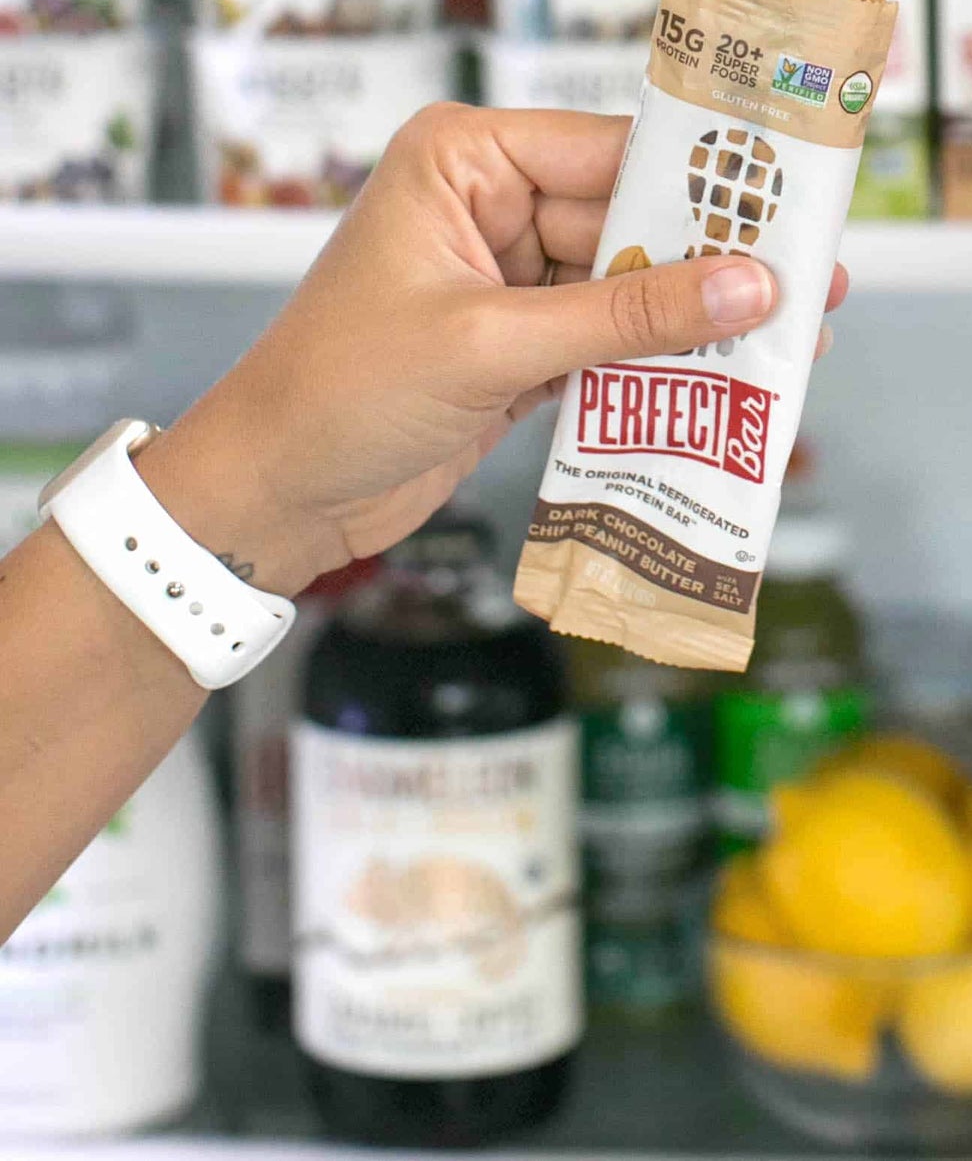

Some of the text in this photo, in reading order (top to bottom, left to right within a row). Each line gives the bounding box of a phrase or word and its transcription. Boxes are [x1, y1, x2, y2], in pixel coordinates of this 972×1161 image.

[660, 9, 705, 53] 15G
[656, 38, 700, 68] PROTEIN
[715, 34, 764, 62] 20+
[710, 66, 758, 89] FOODS
[713, 53, 760, 78] SUPER
[804, 73, 829, 85] GMO
[806, 65, 830, 78] NON
[774, 81, 824, 101] VERIFIED
[711, 89, 791, 122] GLUTEN FREE
[577, 369, 766, 479] PERFECT Bar
[554, 460, 750, 539] THE ORIGINAL REFRIGERATED
[605, 482, 663, 511] PROTEIN
[549, 508, 697, 574] DARK CHOCOLATE
[573, 523, 640, 560] PEANUT
[640, 556, 705, 596] BUTTER
[712, 591, 744, 607] SALT
[715, 581, 740, 596] SEA
